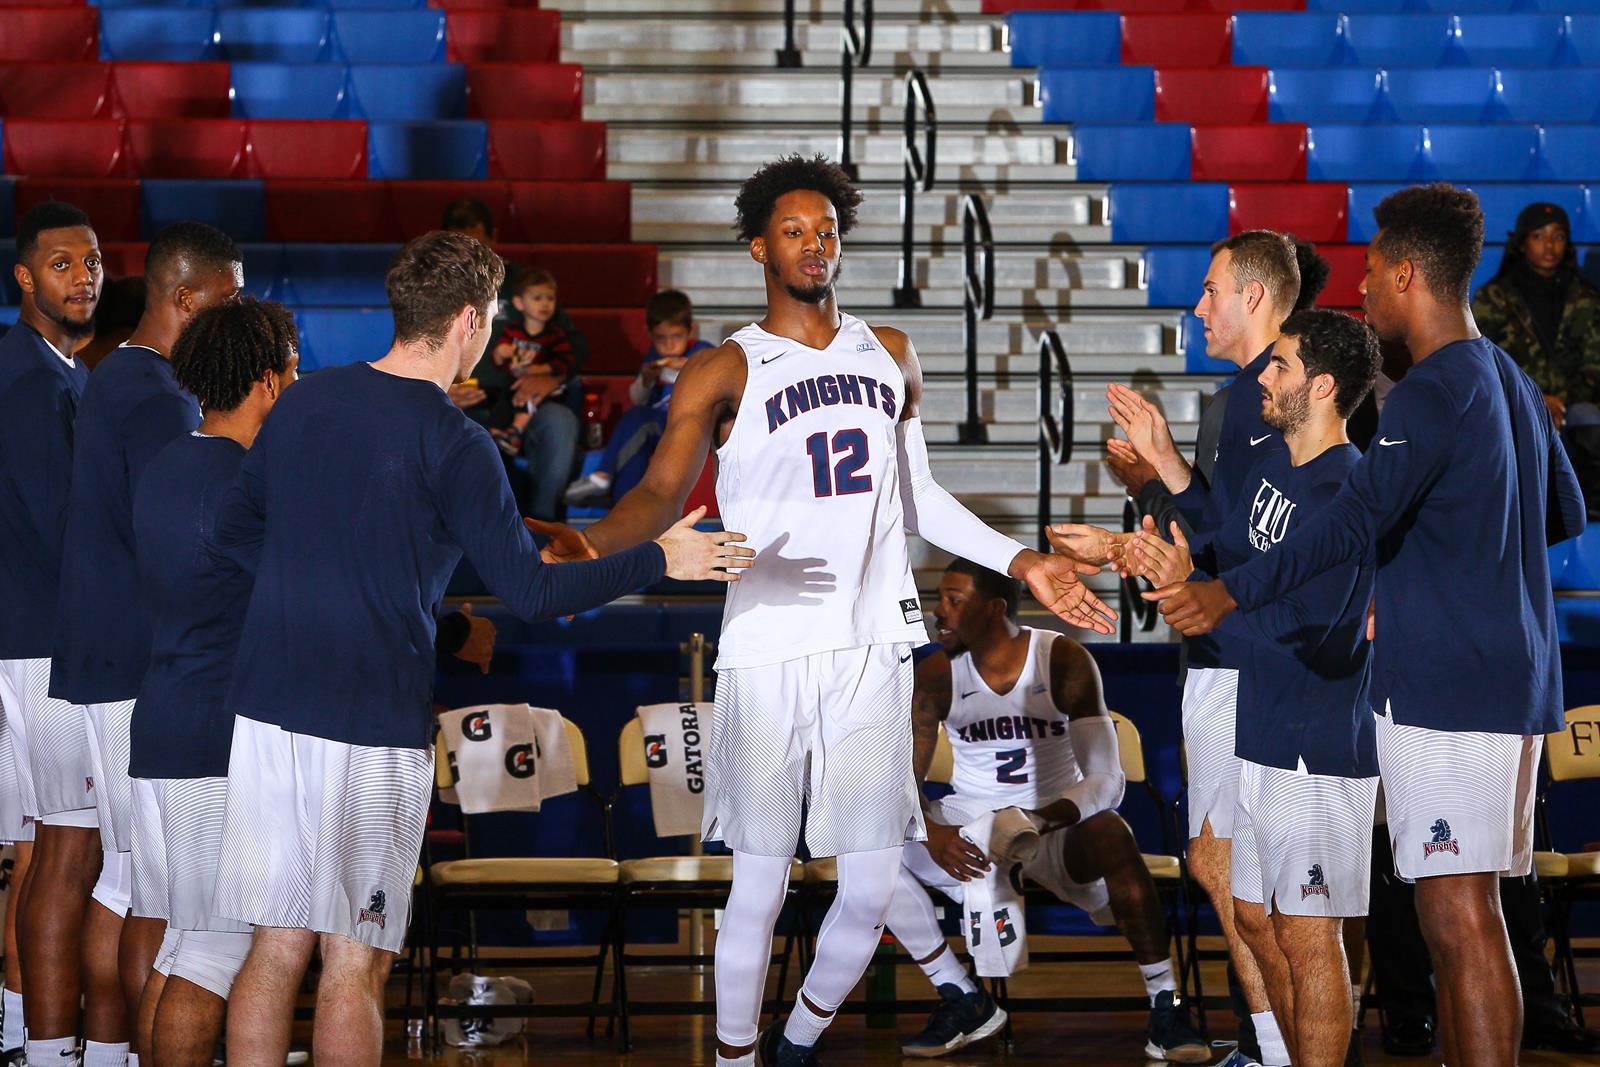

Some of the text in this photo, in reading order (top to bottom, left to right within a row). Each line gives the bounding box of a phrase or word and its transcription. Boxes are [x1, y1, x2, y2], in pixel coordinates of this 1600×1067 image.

[765, 374, 896, 434] KNIGHTS
[806, 428, 872, 498] 12
[904, 601, 916, 610] XL
[461, 710, 492, 742] G
[956, 716, 1065, 743] KNIGHTS
[1566, 721, 1600, 756] F
[505, 743, 535, 779] G
[643, 733, 668, 769] G
[679, 702, 705, 794] GATORA
[995, 748, 1029, 784] 2
